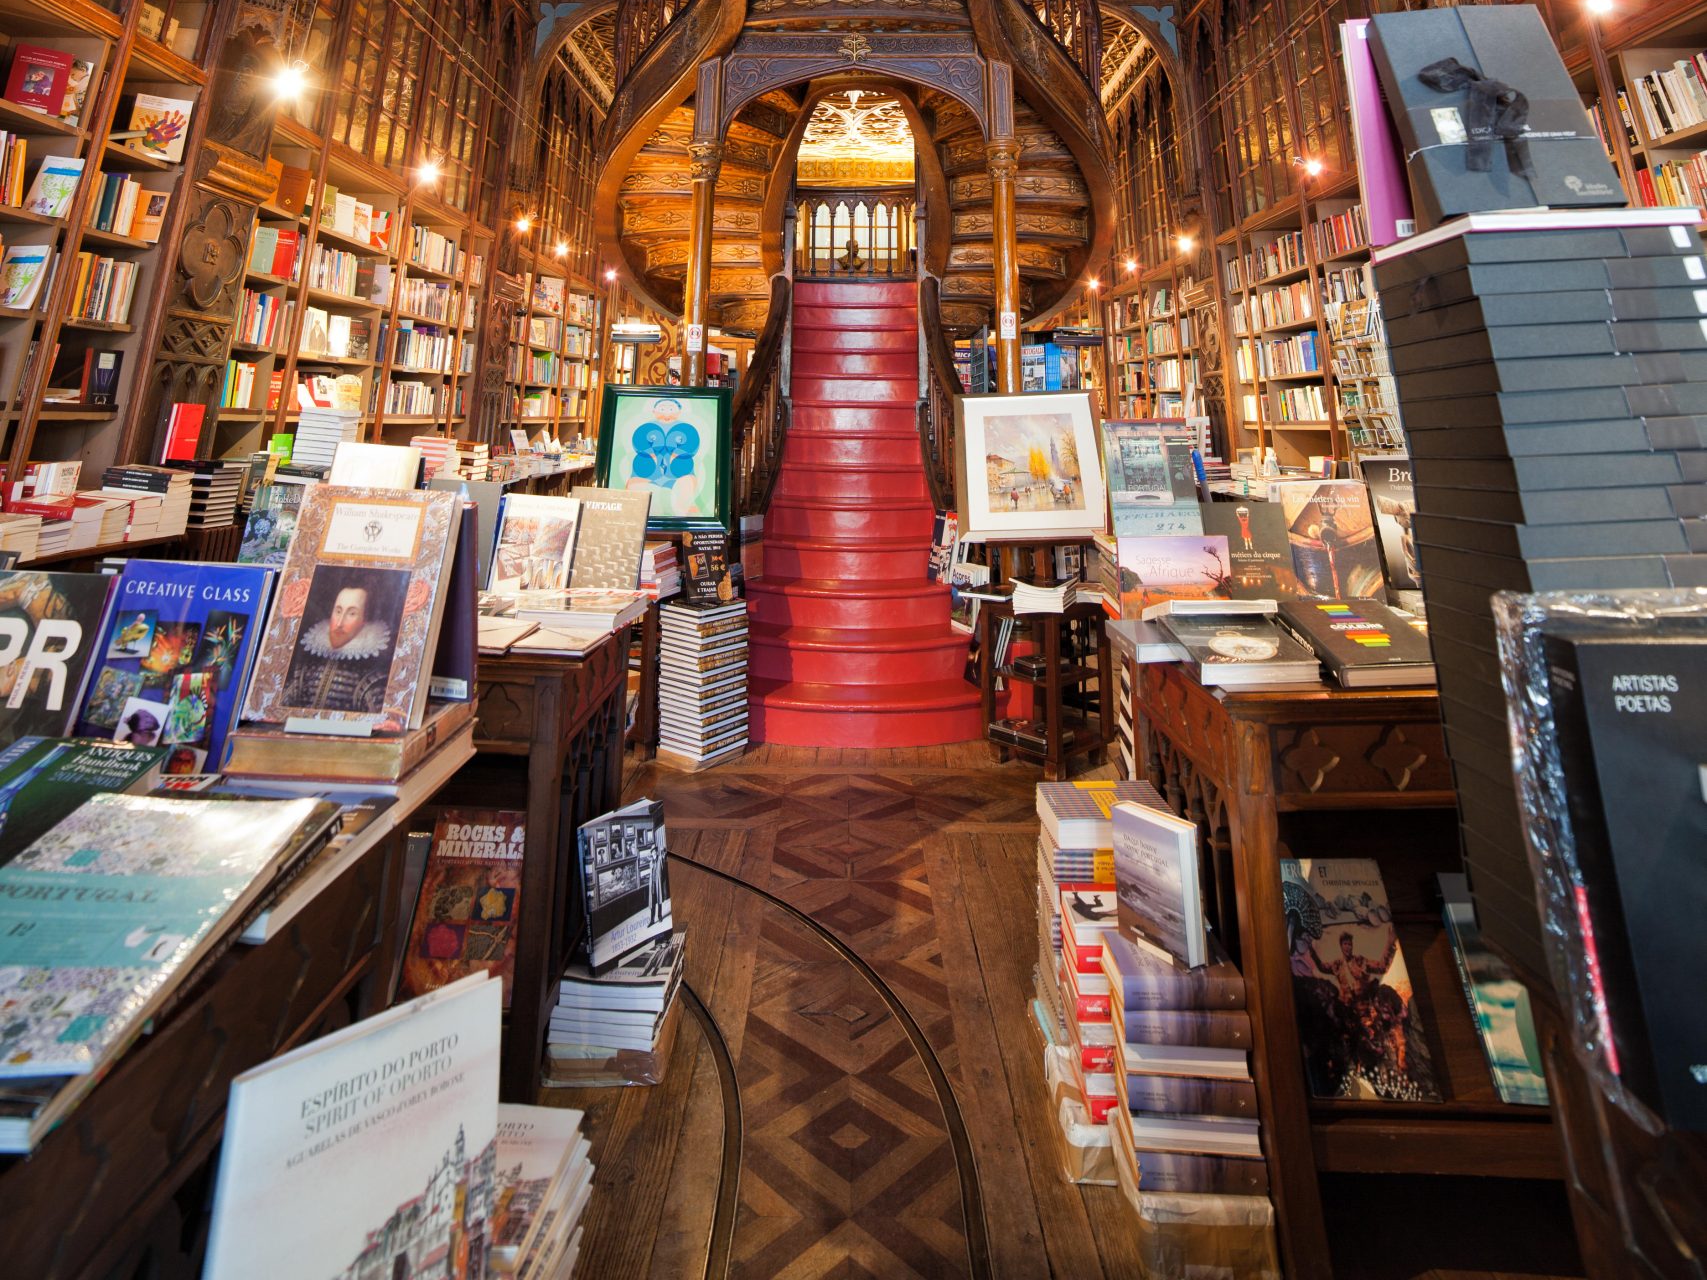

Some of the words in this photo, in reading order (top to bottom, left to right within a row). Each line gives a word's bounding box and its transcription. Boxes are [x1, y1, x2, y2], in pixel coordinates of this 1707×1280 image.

[586, 501, 622, 511] VINTAGE
[952, 568, 971, 583] Açores
[125, 579, 195, 600] CREATIVE
[202, 586, 250, 603] GLASS
[1612, 674, 1679, 693] ARTISTAS
[1614, 694, 1672, 713] POETAS
[71, 755, 141, 771] Handbook
[83, 746, 155, 763] ANTIQUES
[446, 824, 506, 842] ROCKS
[511, 826, 525, 842] &
[300, 1069, 378, 1120] ESPÍRITO
[382, 1058, 405, 1081] DO
[409, 1032, 460, 1065] PORTO
[304, 1098, 359, 1140] SPIRIT
[363, 1088, 385, 1108] OF
[390, 1055, 453, 1094] OPORTO
[497, 1122, 534, 1130] ORTO
[286, 1130, 346, 1169] AGUARELAS
[348, 1123, 362, 1138] DE
[364, 1106, 394, 1130] VASCO
